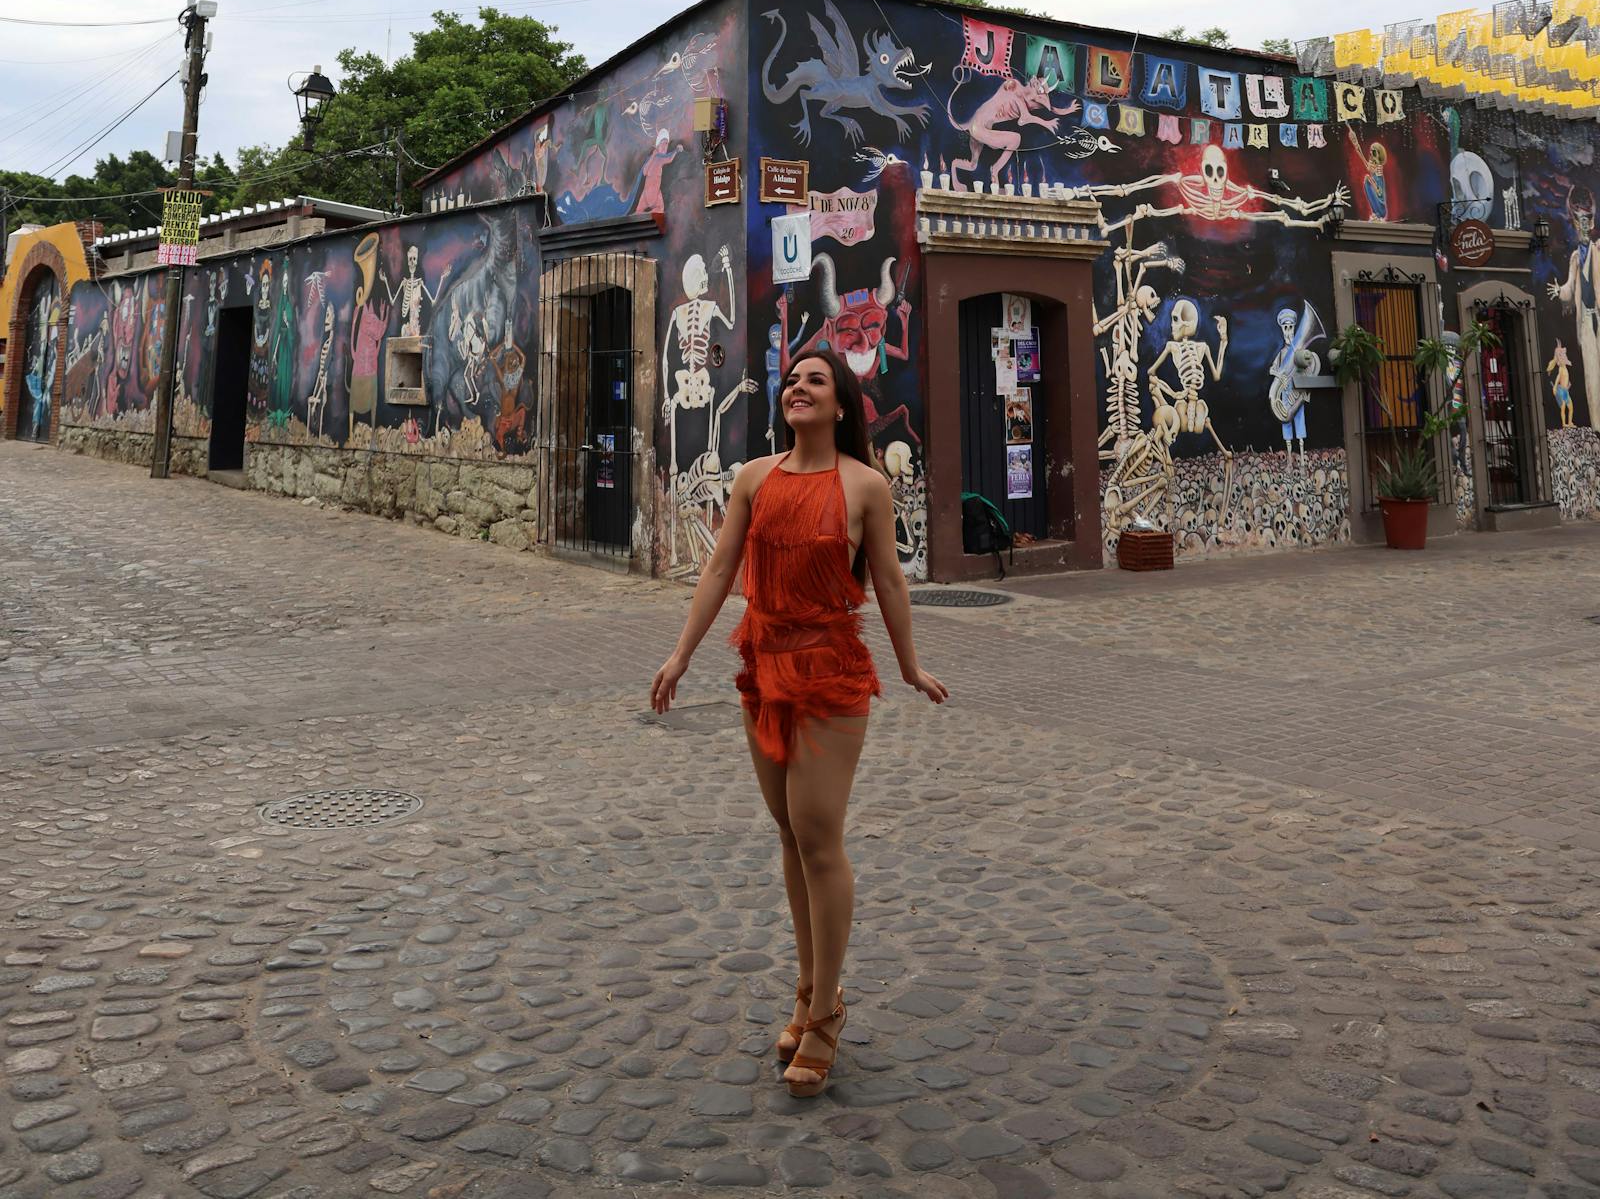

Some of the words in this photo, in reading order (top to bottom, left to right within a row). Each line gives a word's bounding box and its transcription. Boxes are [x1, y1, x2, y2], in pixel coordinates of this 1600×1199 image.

[767, 165, 779, 173] Calle
[786, 167, 802, 175] Ignacio
[713, 175, 731, 184] Hidalgo
[773, 174, 797, 184] Aldama
[166, 190, 203, 204] VENDO
[164, 203, 202, 214] PROPIEDAD
[821, 199, 833, 213] DE
[163, 212, 200, 222] COMERCIAL
[162, 220, 189, 230] FRENTE
[190, 221, 199, 230] AL
[163, 228, 196, 238] ESTADIO
[160, 236, 168, 244] DE
[169, 237, 197, 246] BEISBOL
